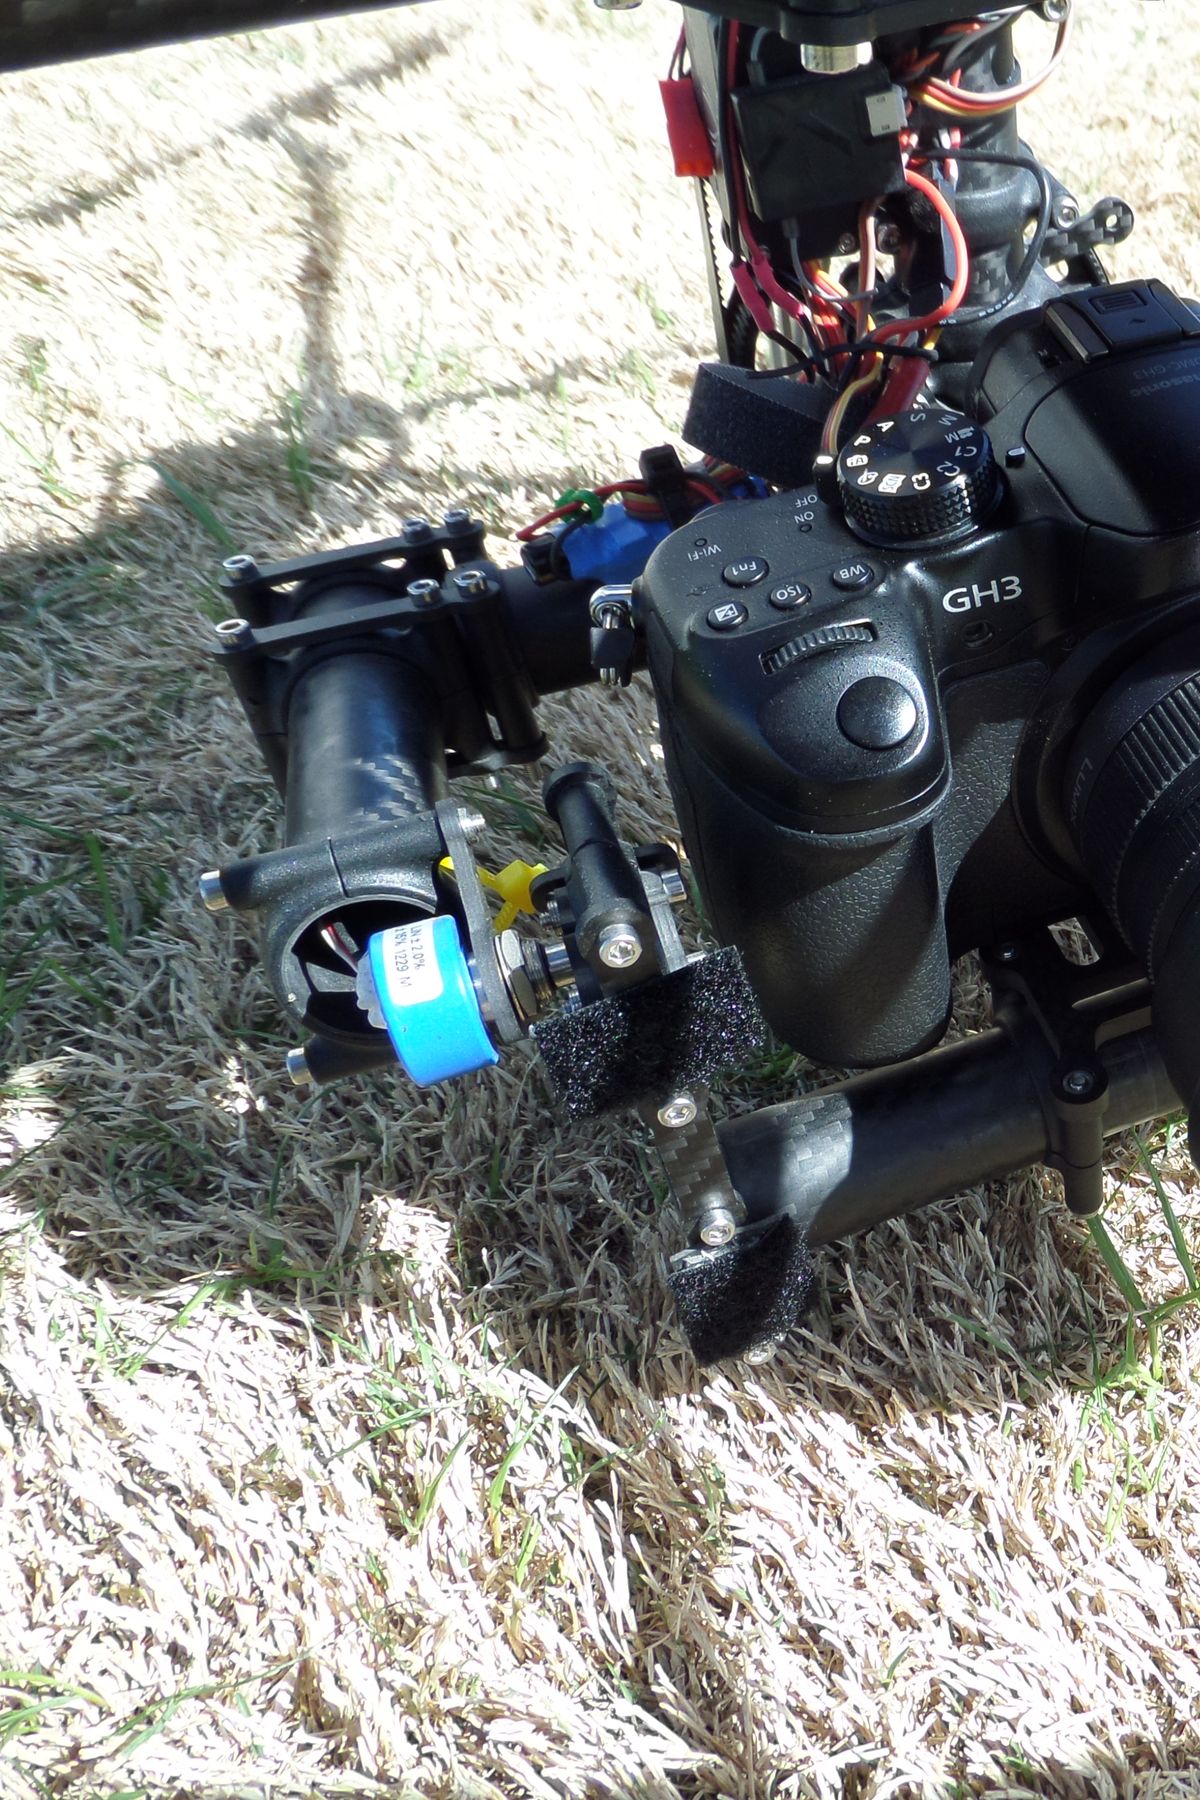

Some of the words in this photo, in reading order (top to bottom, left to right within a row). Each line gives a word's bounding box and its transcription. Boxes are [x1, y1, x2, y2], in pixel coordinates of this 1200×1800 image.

[910, 413, 926, 422] S
[938, 414, 958, 426] M
[876, 421, 895, 432] A
[853, 435, 871, 446] P
[955, 446, 977, 457] C1
[936, 461, 960, 477] C2
[795, 494, 818, 508] OFF
[794, 511, 815, 524] ON
[731, 561, 757, 576] Fn1
[839, 564, 866, 579] WB
[776, 585, 802, 601] ISO
[942, 575, 1022, 613] GH3
